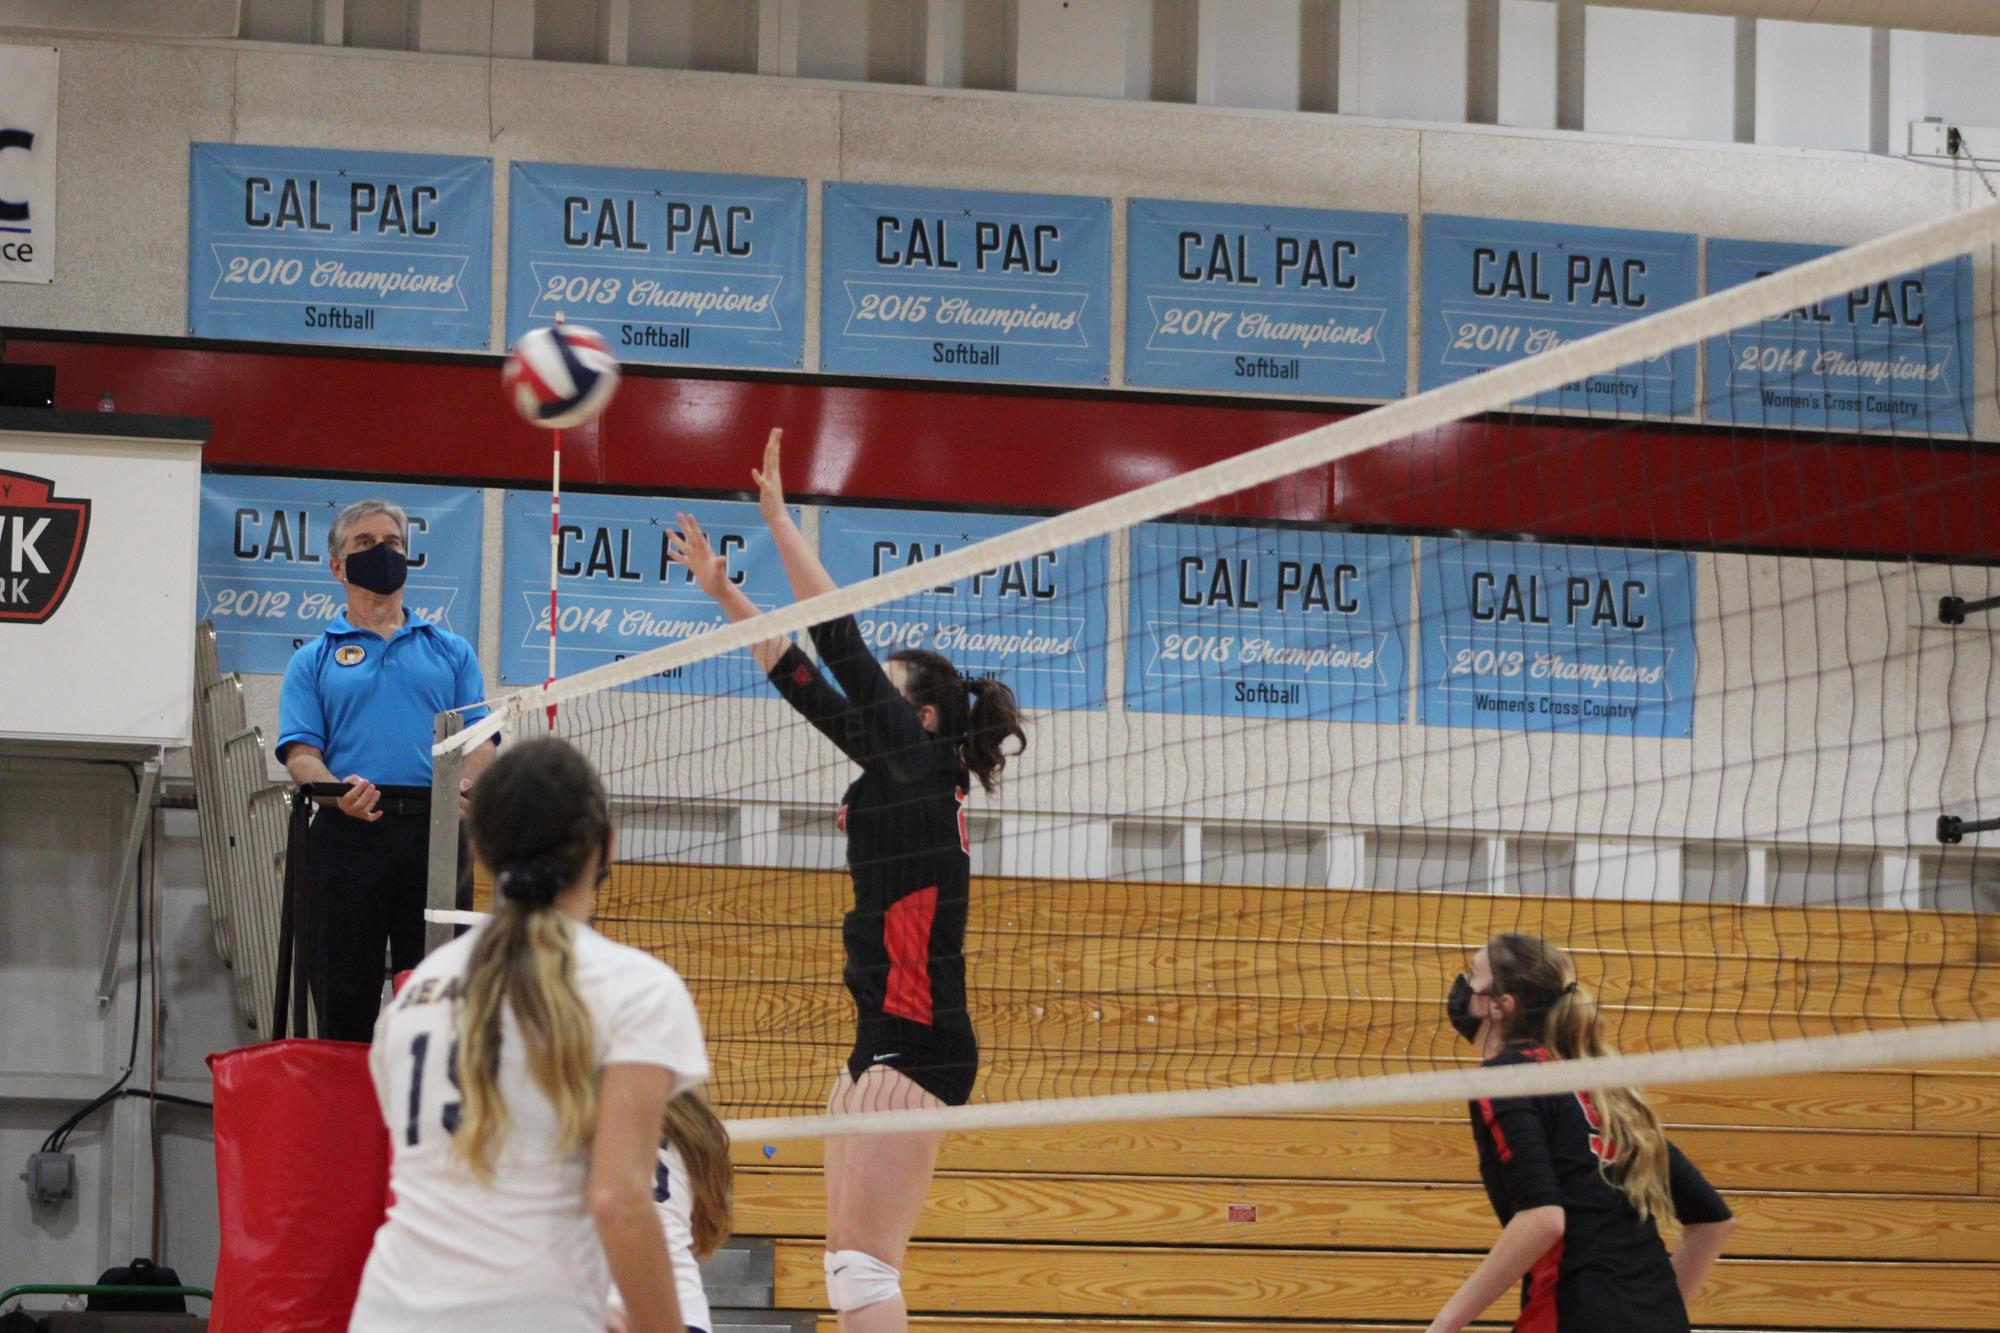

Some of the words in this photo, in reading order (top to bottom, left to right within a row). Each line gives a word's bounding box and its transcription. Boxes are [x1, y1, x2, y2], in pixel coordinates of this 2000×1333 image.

[245, 177, 333, 231] CAL
[351, 183, 438, 237] PAC
[564, 196, 648, 251] CAL
[667, 203, 753, 257] PAC
[876, 216, 960, 270] CAL
[976, 222, 1060, 275] PAC
[1178, 231, 1259, 285] CAL
[1276, 237, 1357, 289] PAC
[224, 256, 303, 286] 2010
[310, 258, 457, 299] Champions
[543, 275, 620, 305] 2013
[627, 277, 771, 316] Champions
[1473, 248, 1551, 302] CAL
[1568, 255, 1647, 308] PAC
[305, 306, 374, 330] Softball
[856, 294, 931, 323] 2015
[935, 296, 1076, 334] Champions
[1847, 280, 1924, 327] PAC
[621, 325, 689, 348] Softball
[1160, 309, 1232, 341] 2017
[1236, 310, 1374, 348] Champions
[1454, 323, 1521, 352] 2011
[933, 342, 999, 365] Softball
[1234, 356, 1299, 380] Softball
[1738, 346, 1808, 372] 2014
[1812, 349, 1940, 384] Champions
[1585, 375, 1639, 399] Country
[1762, 390, 1820, 410] Women's
[1824, 394, 1861, 411] Cross
[1866, 396, 1918, 417] Country
[234, 508, 322, 563] CAL
[558, 525, 643, 582] CAL
[212, 589, 290, 618] 2012
[1179, 556, 1259, 611] CAL
[1277, 561, 1360, 615] PAC
[1472, 572, 1550, 625] CAL
[1567, 578, 1647, 630] PAC
[859, 620, 928, 648] 2016
[932, 622, 1073, 659] Champions
[1161, 634, 1235, 662] 2018
[1238, 637, 1375, 673] Champions
[1452, 648, 1524, 676] 2013
[1530, 651, 1663, 689] Champions
[1234, 682, 1299, 704] Softball
[1476, 693, 1536, 714] Women's
[1539, 697, 1579, 716] Cross
[1583, 699, 1638, 722] Country
